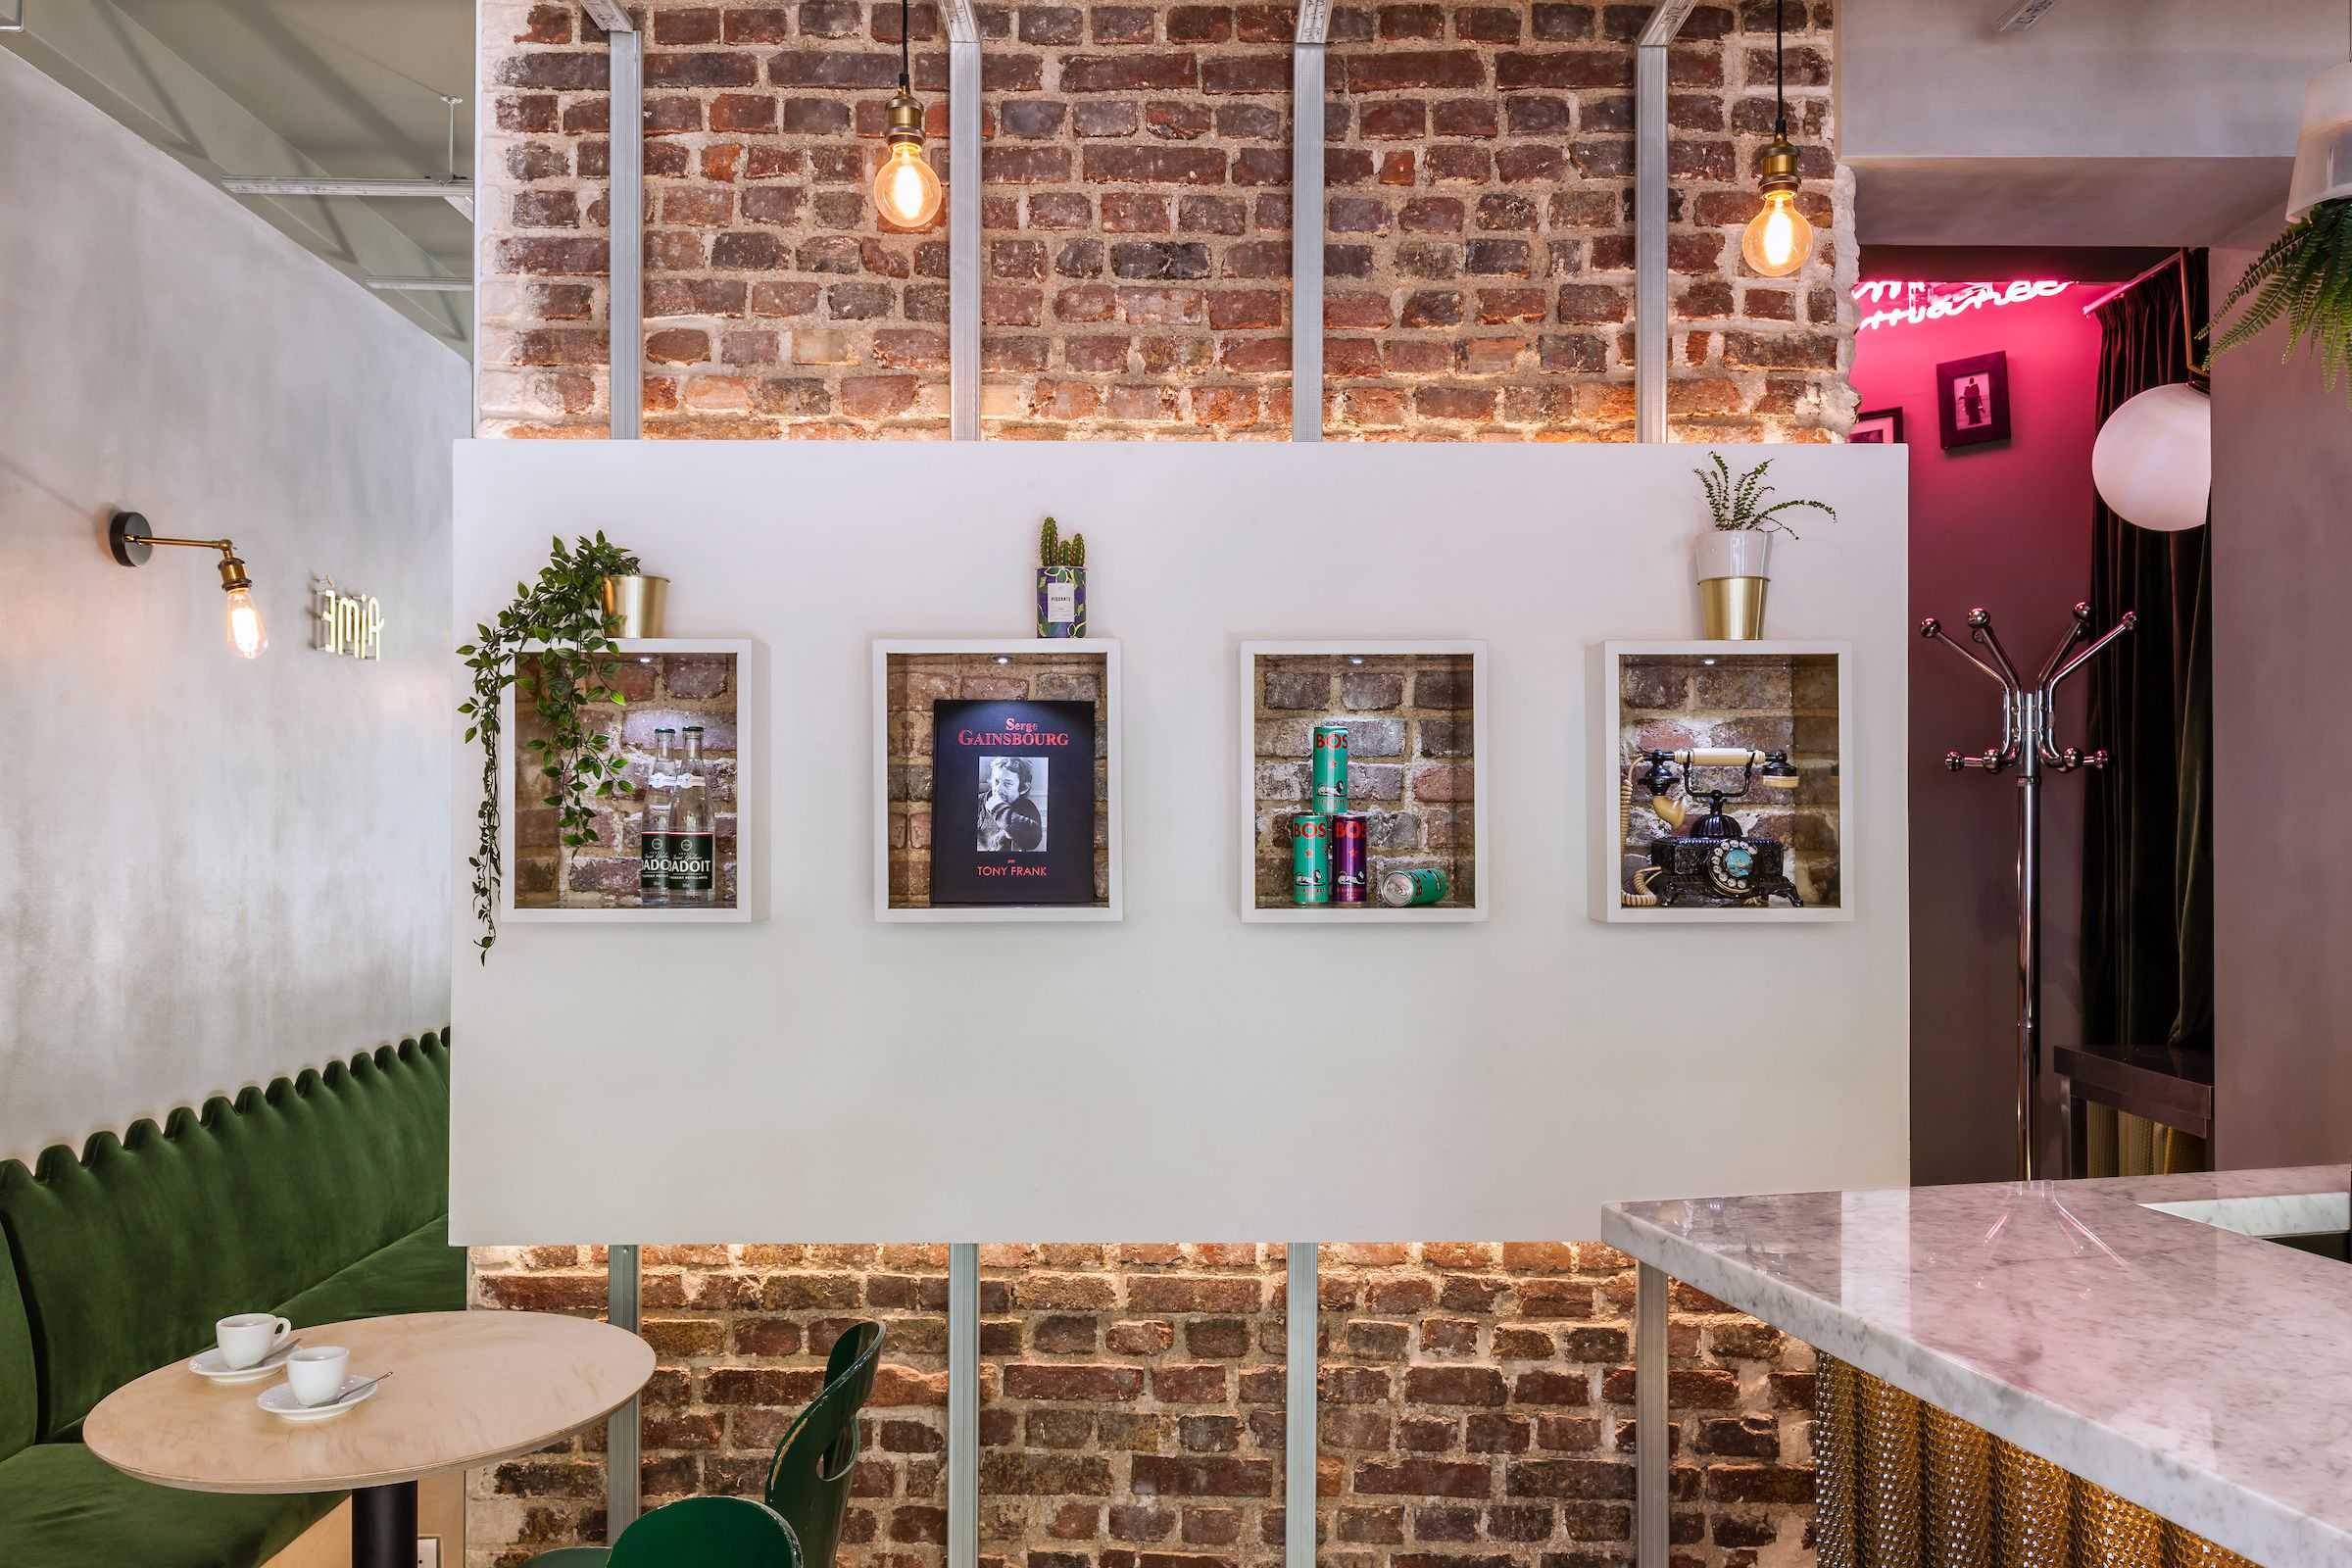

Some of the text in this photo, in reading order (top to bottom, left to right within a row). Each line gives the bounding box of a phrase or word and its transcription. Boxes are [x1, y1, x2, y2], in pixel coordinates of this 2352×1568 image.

[1005, 717, 1039, 732] Serge
[957, 729, 1069, 746] GAINSBOURG
[1316, 733, 1348, 750] BOS
[1294, 822, 1326, 839] BOS
[1336, 821, 1365, 839] BO
[977, 866, 1048, 876] TONY FRANK
